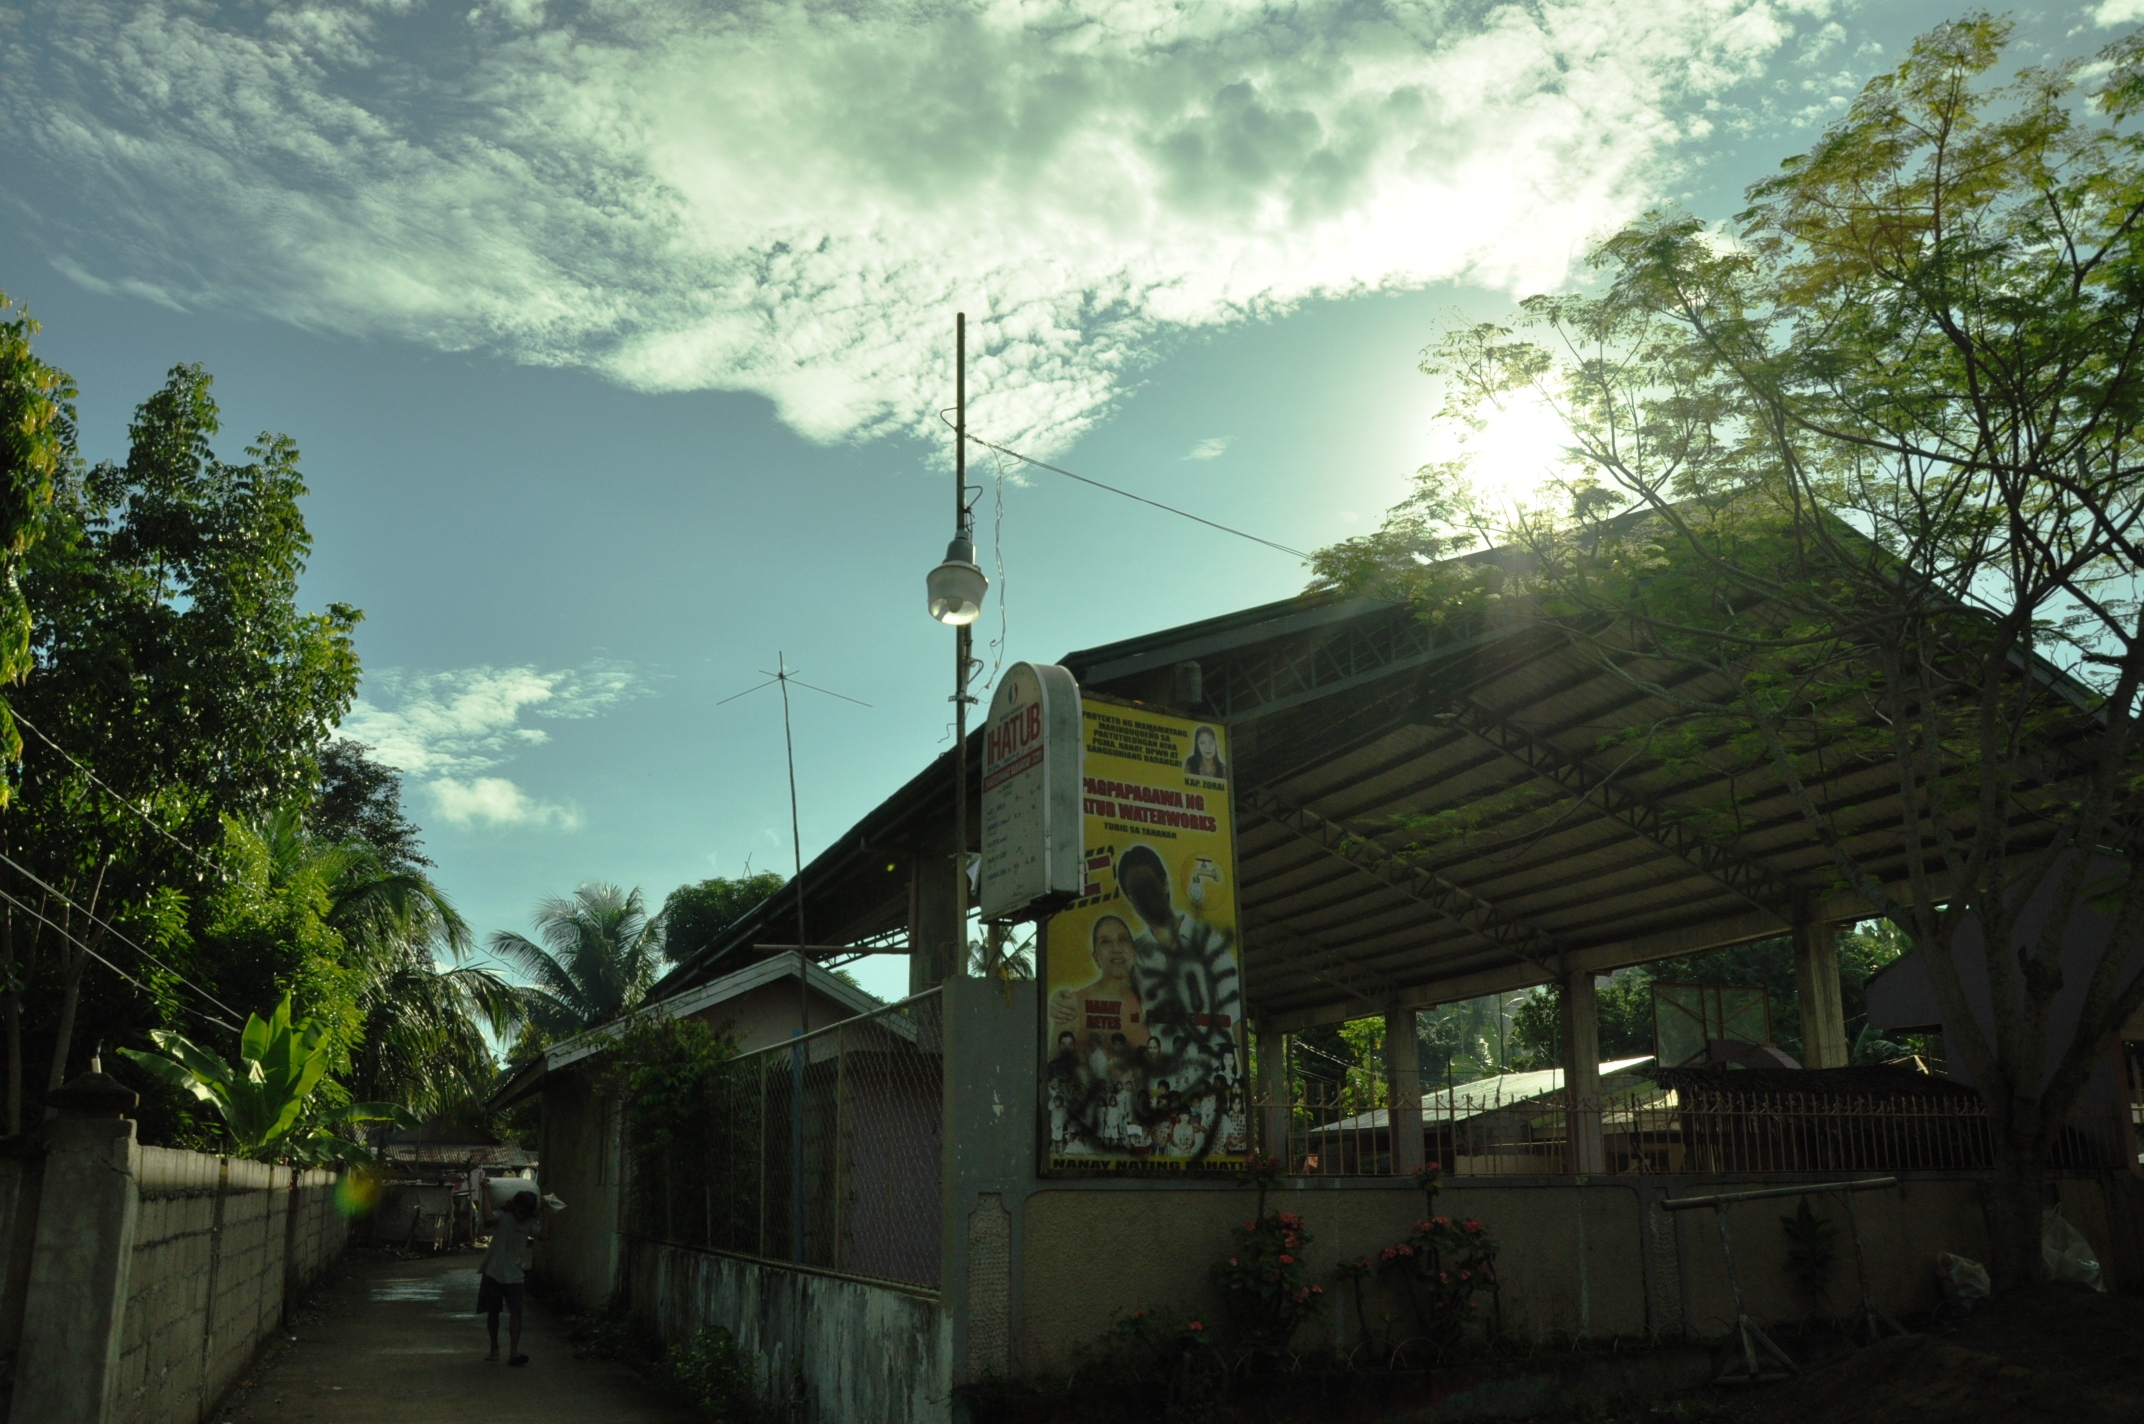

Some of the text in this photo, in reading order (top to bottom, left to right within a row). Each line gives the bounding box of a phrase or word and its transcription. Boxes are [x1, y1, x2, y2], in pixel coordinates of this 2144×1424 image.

[1082, 710, 1188, 738] PROYEKTO NG MAMAMAYANG
[987, 702, 1041, 766] IHATUB
[1094, 729, 1157, 747] PAGTUTULUNGAN
[1160, 734, 1171, 742] SA
[1086, 744, 1183, 767] SANGGUNIANG BARANGAY
[1170, 751, 1178, 759] AT
[1083, 777, 1205, 811] PAGPAPAGAWA NG
[1118, 803, 1217, 832] WATERWORKS
[1104, 822, 1177, 839] TUBIG SA TAHANAN
[1086, 1014, 1121, 1030] REYES
[1053, 1159, 1111, 1169] NANAY
[1115, 1160, 1180, 1170] NATING
